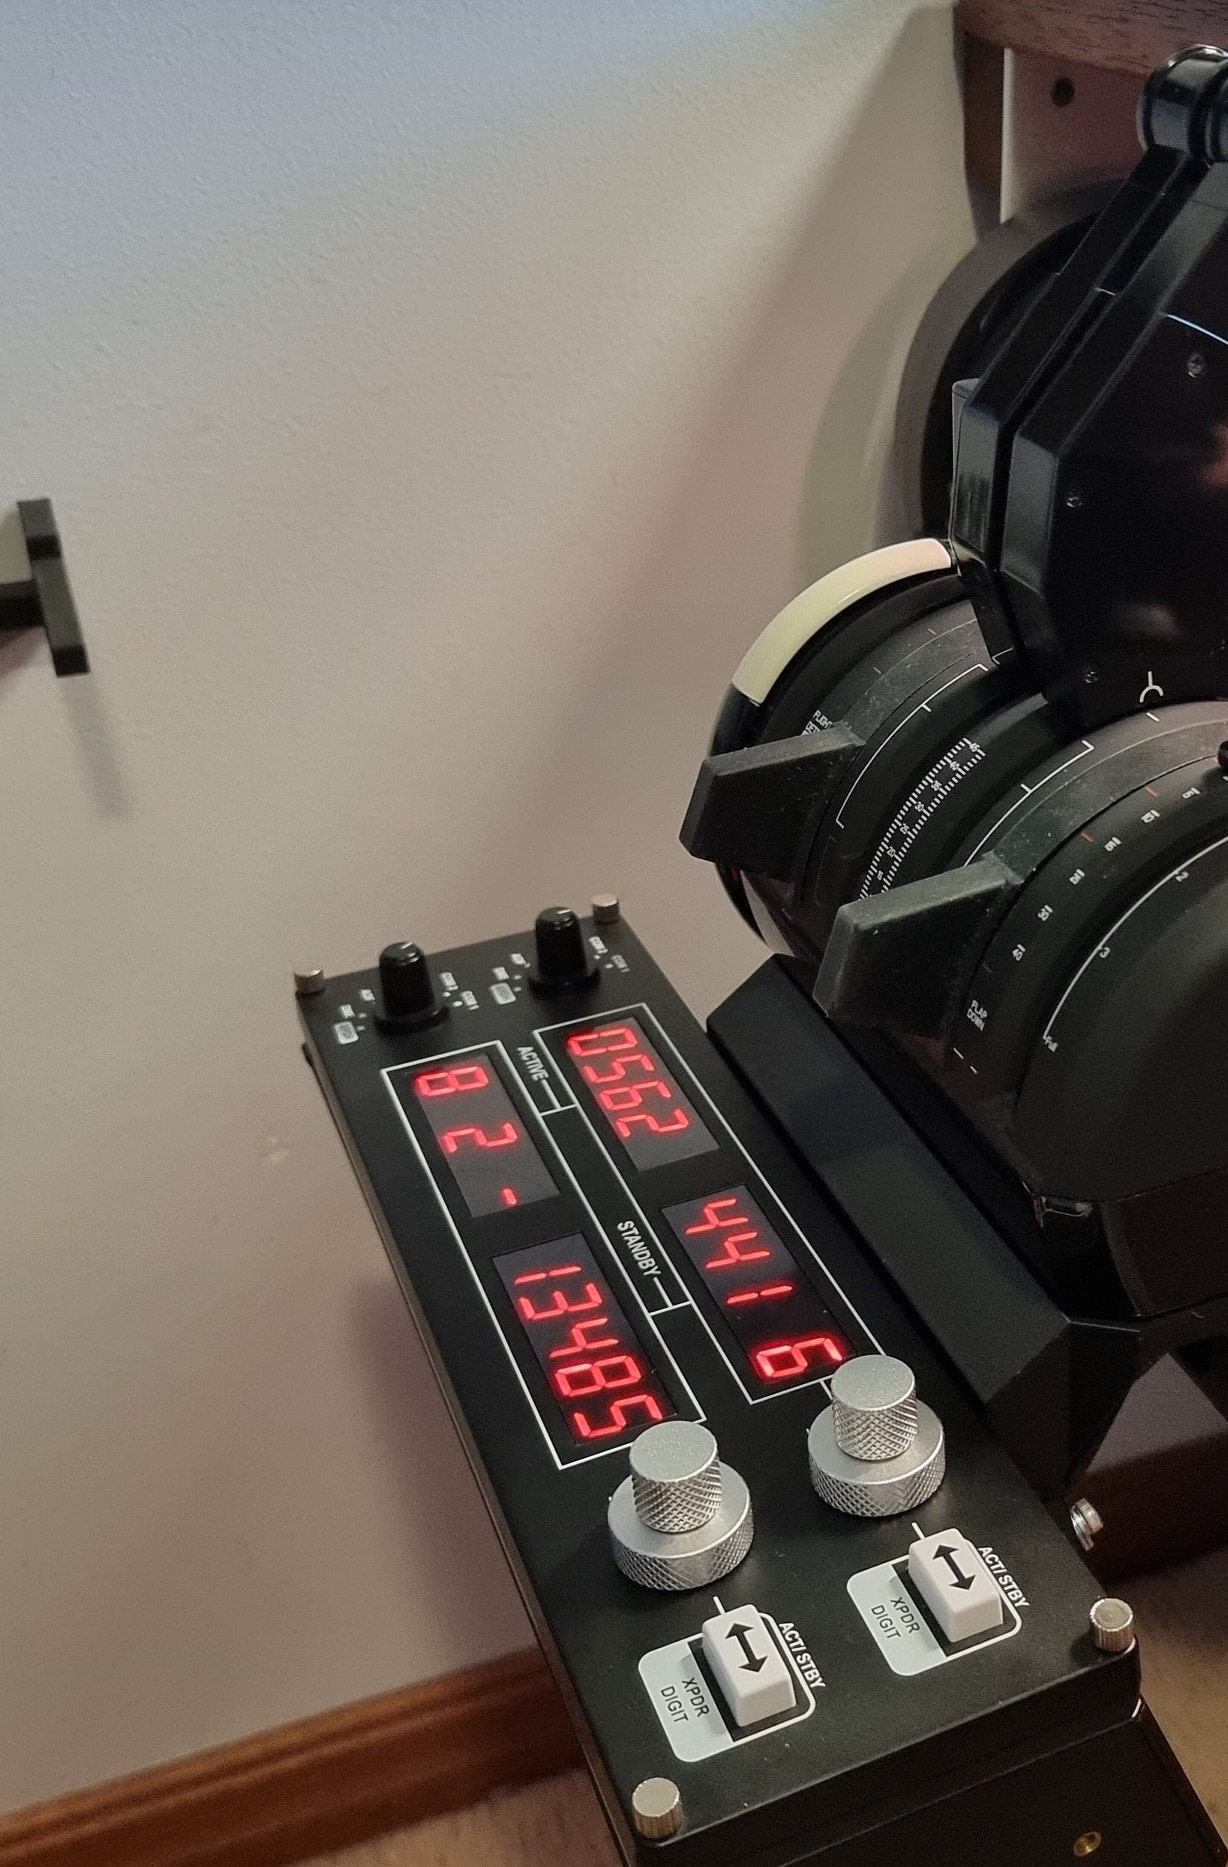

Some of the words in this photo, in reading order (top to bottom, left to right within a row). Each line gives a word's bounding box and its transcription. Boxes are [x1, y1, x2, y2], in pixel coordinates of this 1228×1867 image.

[1174, 871, 1190, 883] 2
[1098, 946, 1111, 960] 3
[517, 1045, 550, 1082] ACTIVE
[567, 1026, 690, 1138] 0562
[616, 1220, 663, 1281] STANDBY
[514, 1264, 664, 1438] 13485
[870, 1604, 902, 1641] DIGIT
[889, 1596, 921, 1635] XPDR
[660, 1685, 690, 1724] DIGIT
[681, 1676, 711, 1718] XPDR
